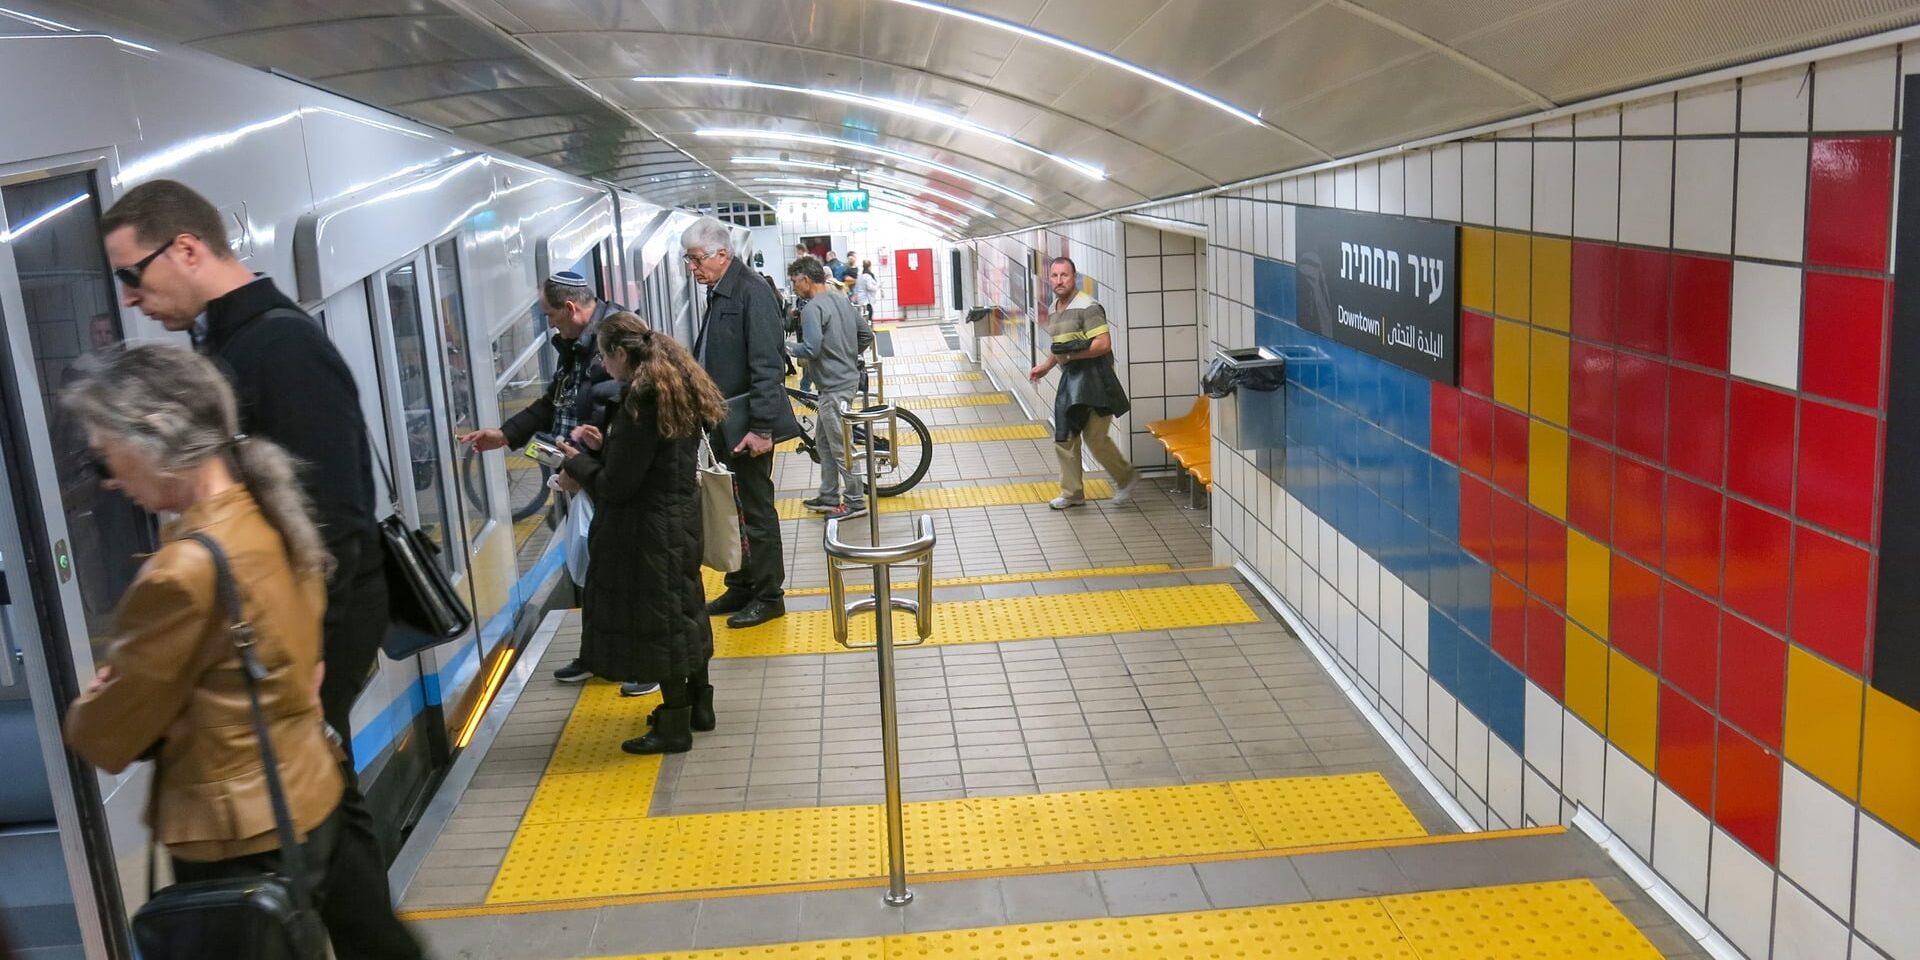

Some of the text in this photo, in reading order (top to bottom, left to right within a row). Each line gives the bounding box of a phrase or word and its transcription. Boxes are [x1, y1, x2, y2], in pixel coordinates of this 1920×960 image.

[1340, 241, 1444, 304] עיר תחתית
[1338, 304, 1380, 337] Downtown
[1418, 330, 1443, 362] البلدة
